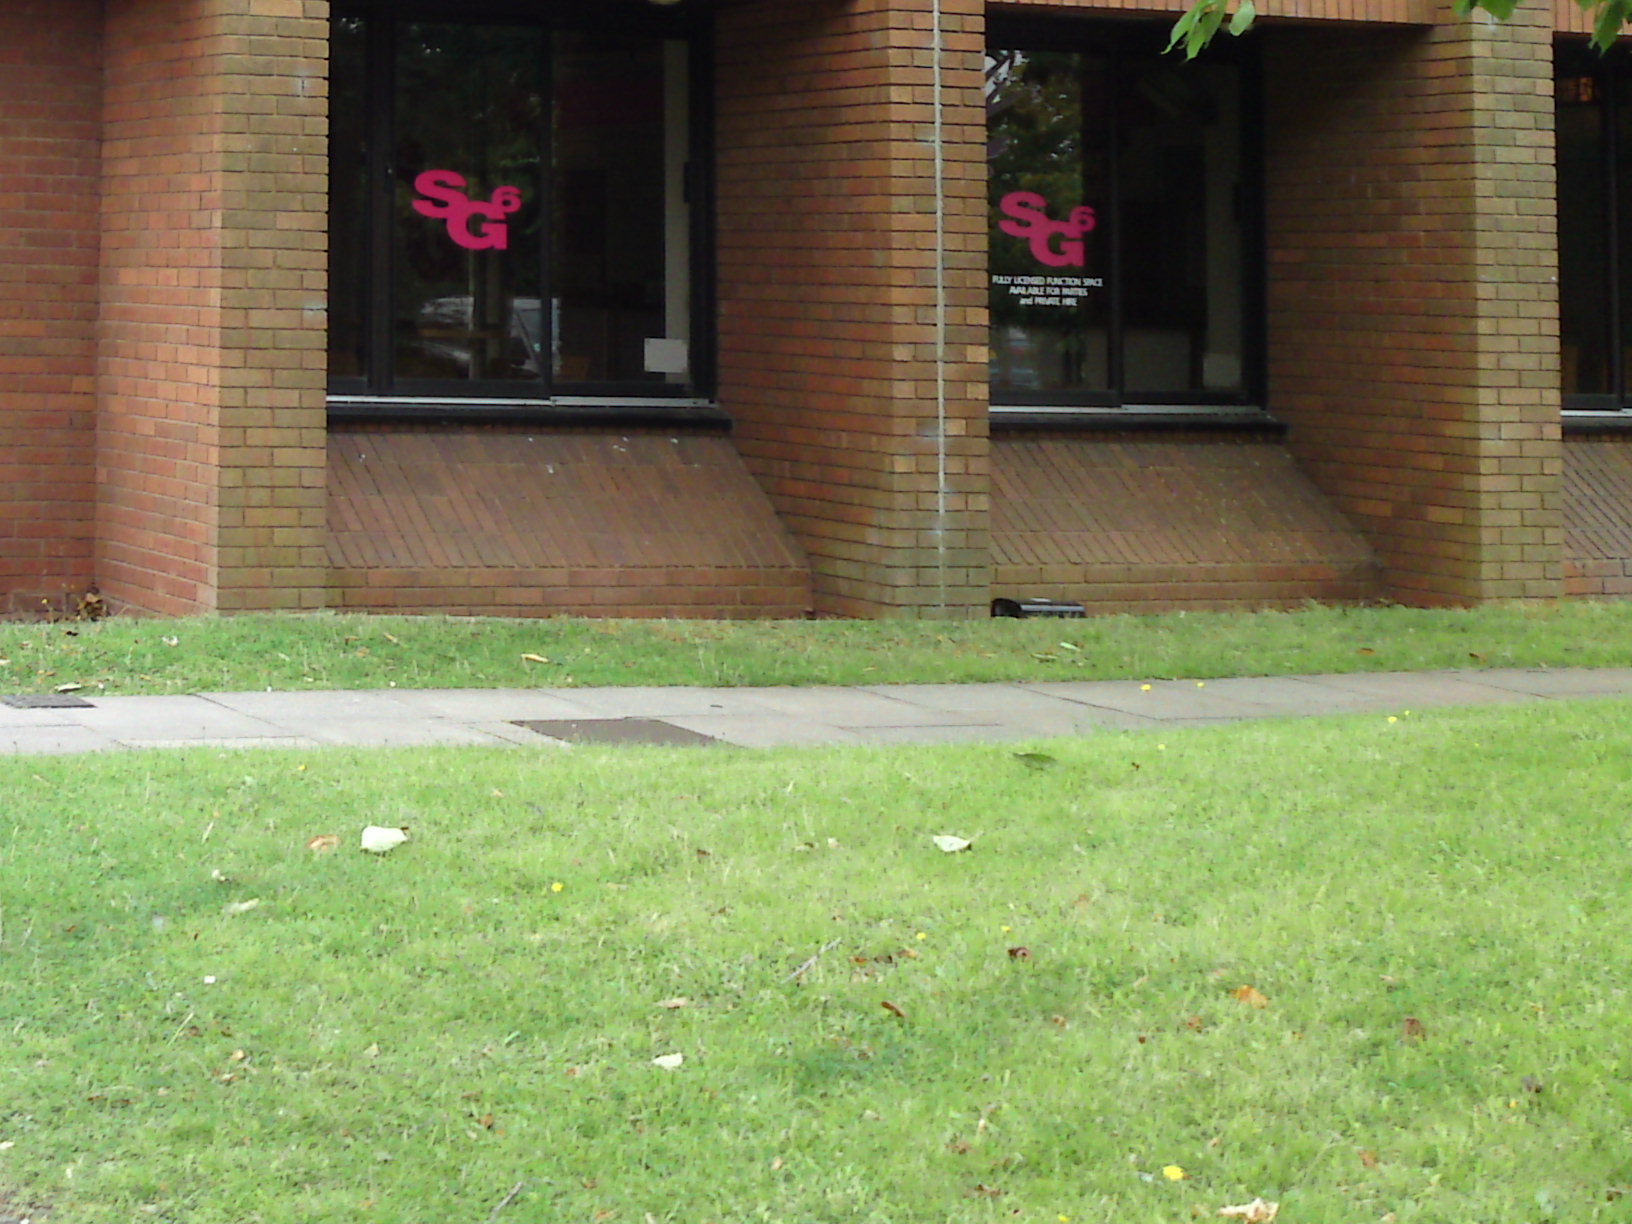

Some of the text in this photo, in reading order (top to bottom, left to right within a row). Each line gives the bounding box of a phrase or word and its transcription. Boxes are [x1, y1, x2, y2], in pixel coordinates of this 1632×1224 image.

[991, 274, 1012, 285] FULLY
[1046, 276, 1082, 287] FUNCTION
[1082, 277, 1104, 288] SPACE
[1008, 285, 1088, 297] AVAILABLE FOR PARTIES
[1034, 296, 1061, 307] PRIVATE
